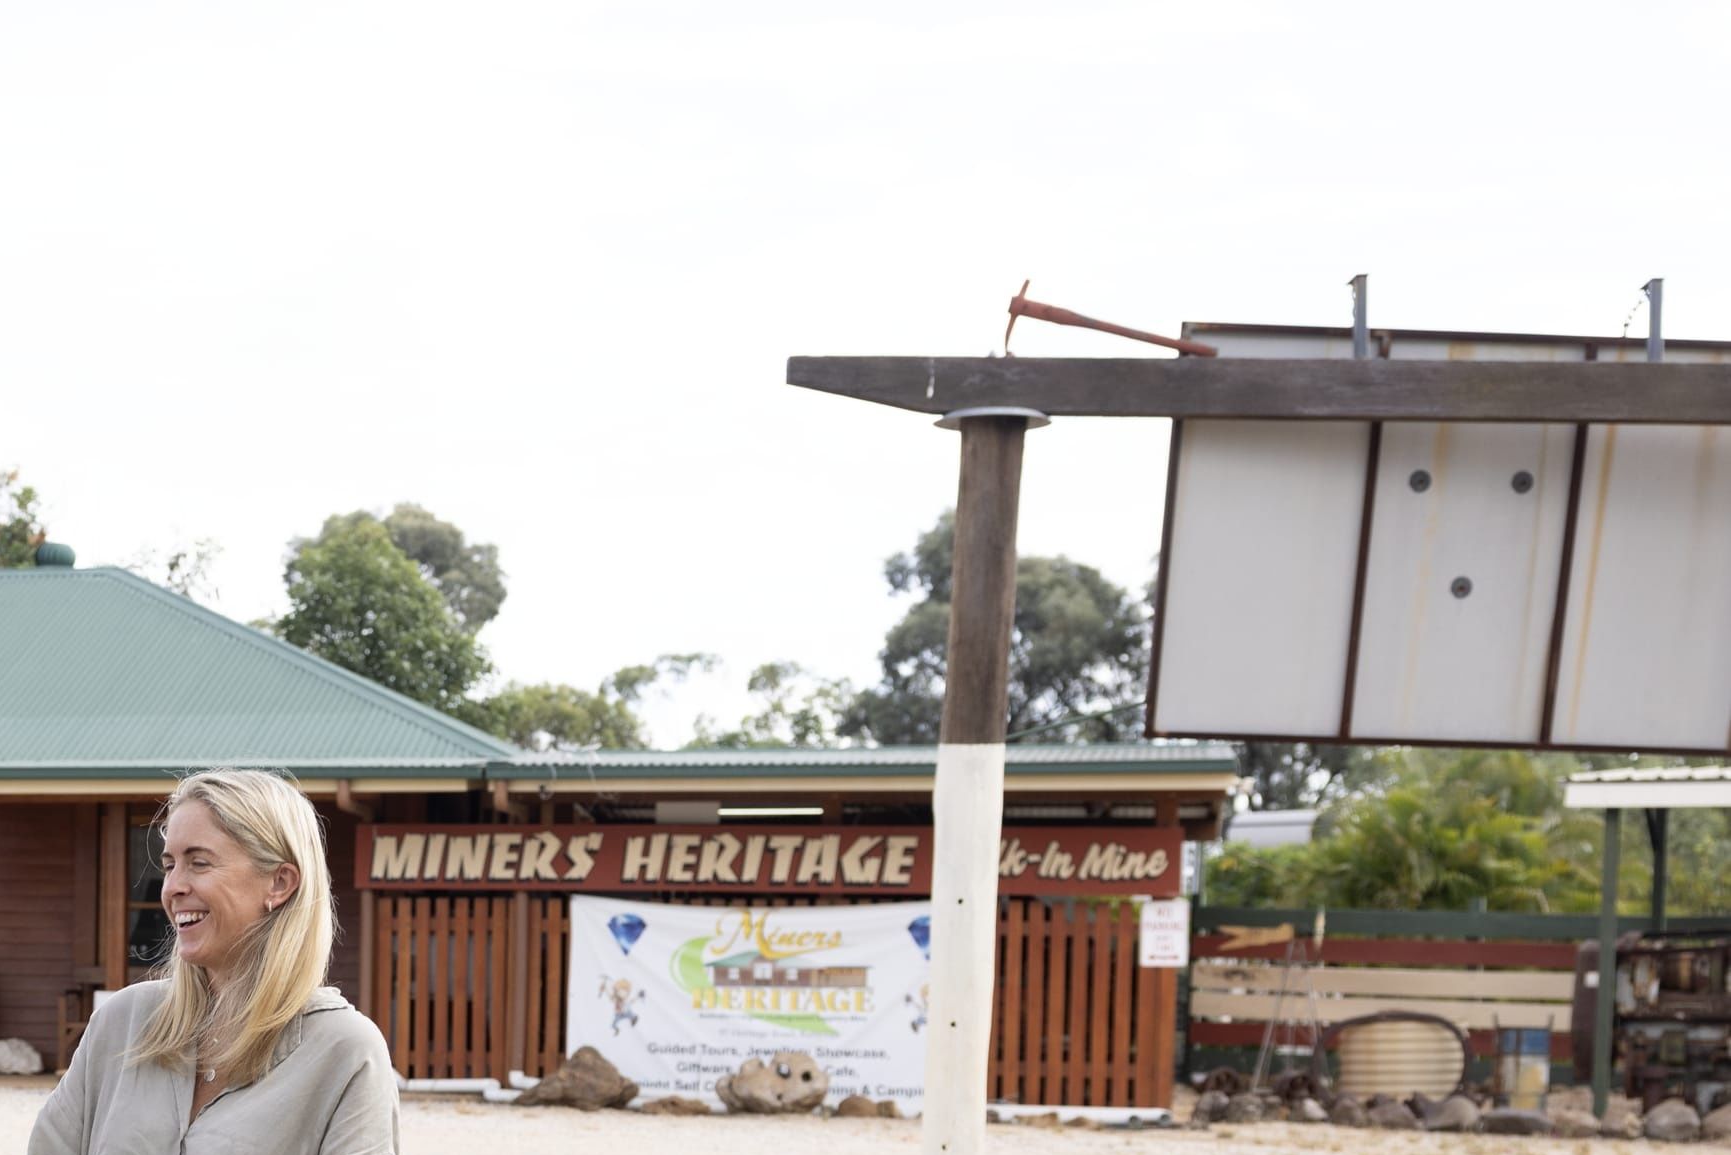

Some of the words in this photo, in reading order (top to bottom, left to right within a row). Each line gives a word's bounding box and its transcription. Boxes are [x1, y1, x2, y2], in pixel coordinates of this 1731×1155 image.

[370, 831, 604, 882] MINERS
[620, 832, 919, 886] HERITAGE
[999, 839, 1076, 879] lk-In
[1078, 841, 1169, 881] Mine
[711, 905, 843, 960] Miners
[692, 986, 876, 1013] HERITAGE
[647, 1042, 698, 1055] Guided
[702, 1043, 742, 1057] Tours,
[816, 1047, 891, 1060] Showcase,
[674, 1079, 700, 1091] Self
[862, 1084, 871, 1095] &
[876, 1084, 925, 1098] Campi
